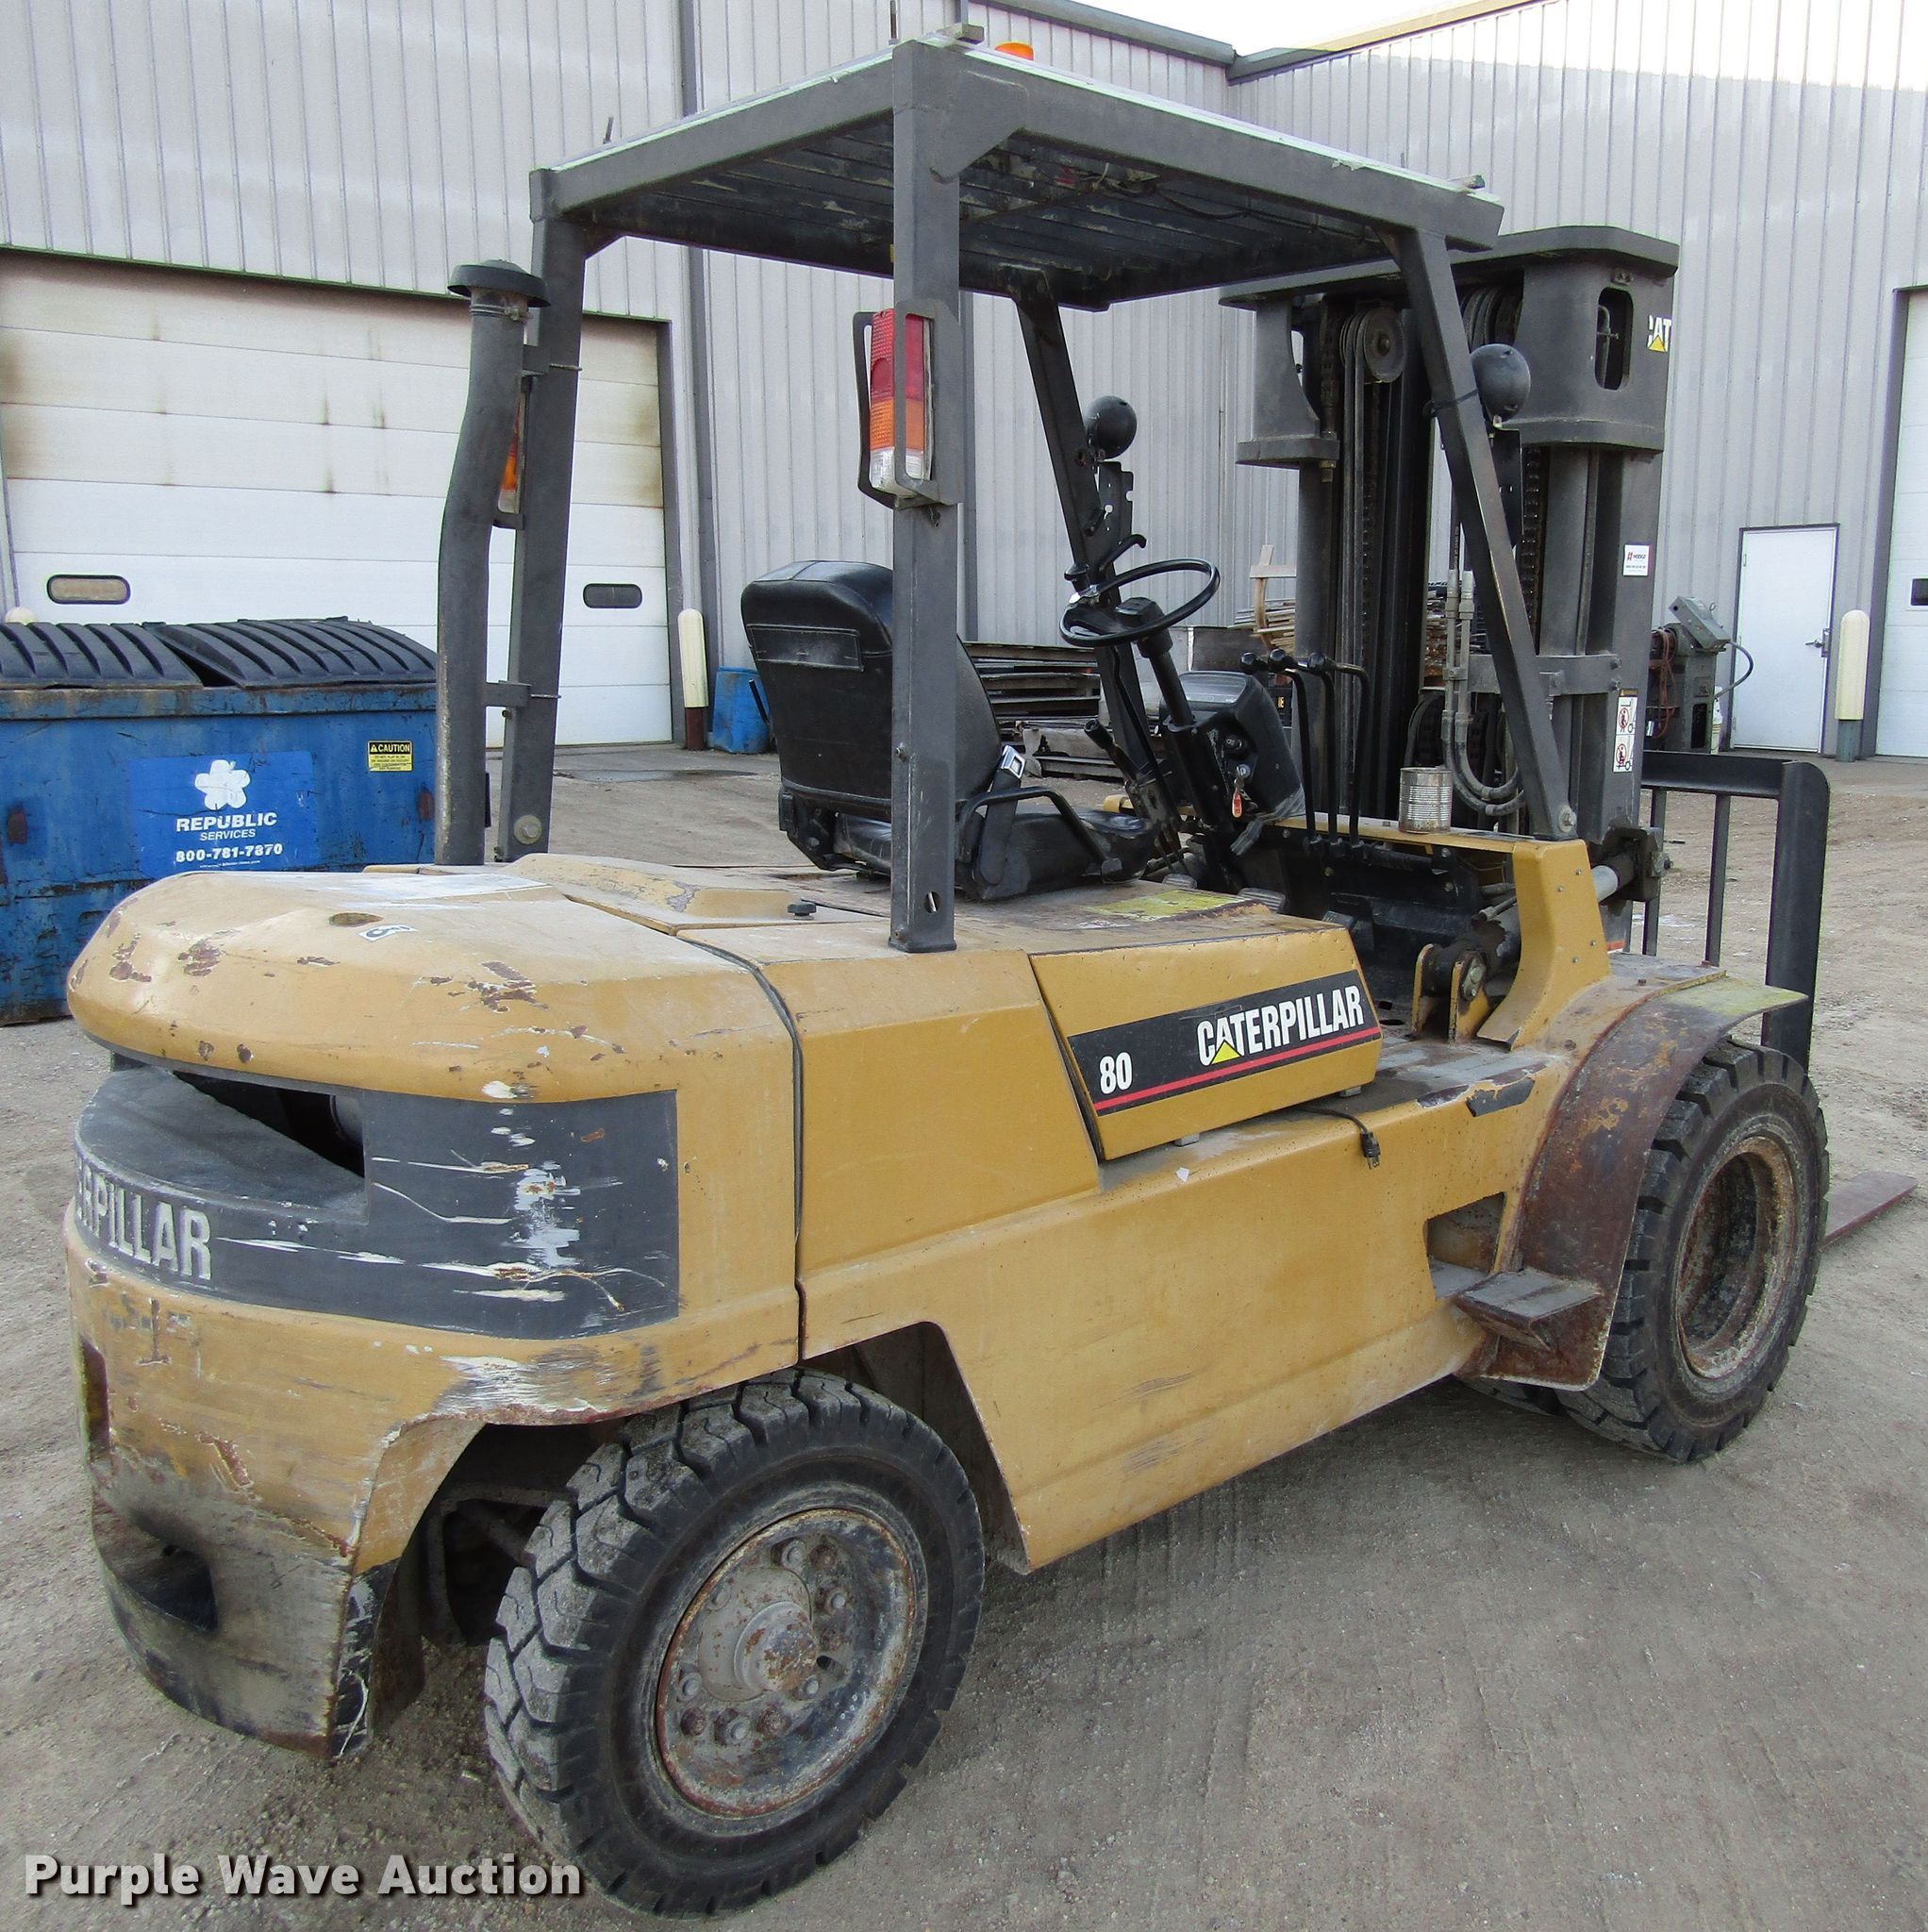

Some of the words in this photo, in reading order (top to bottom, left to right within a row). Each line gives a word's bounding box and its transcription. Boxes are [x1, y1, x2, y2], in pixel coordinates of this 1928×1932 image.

[378, 743, 410, 753] CAUTION
[175, 812, 278, 832] REPUBLIC
[199, 828, 257, 841] SERVICES
[175, 843, 283, 862] 800-781-7870
[1196, 985, 1365, 1067] CATERPILLAR
[1099, 1052, 1133, 1094] 80
